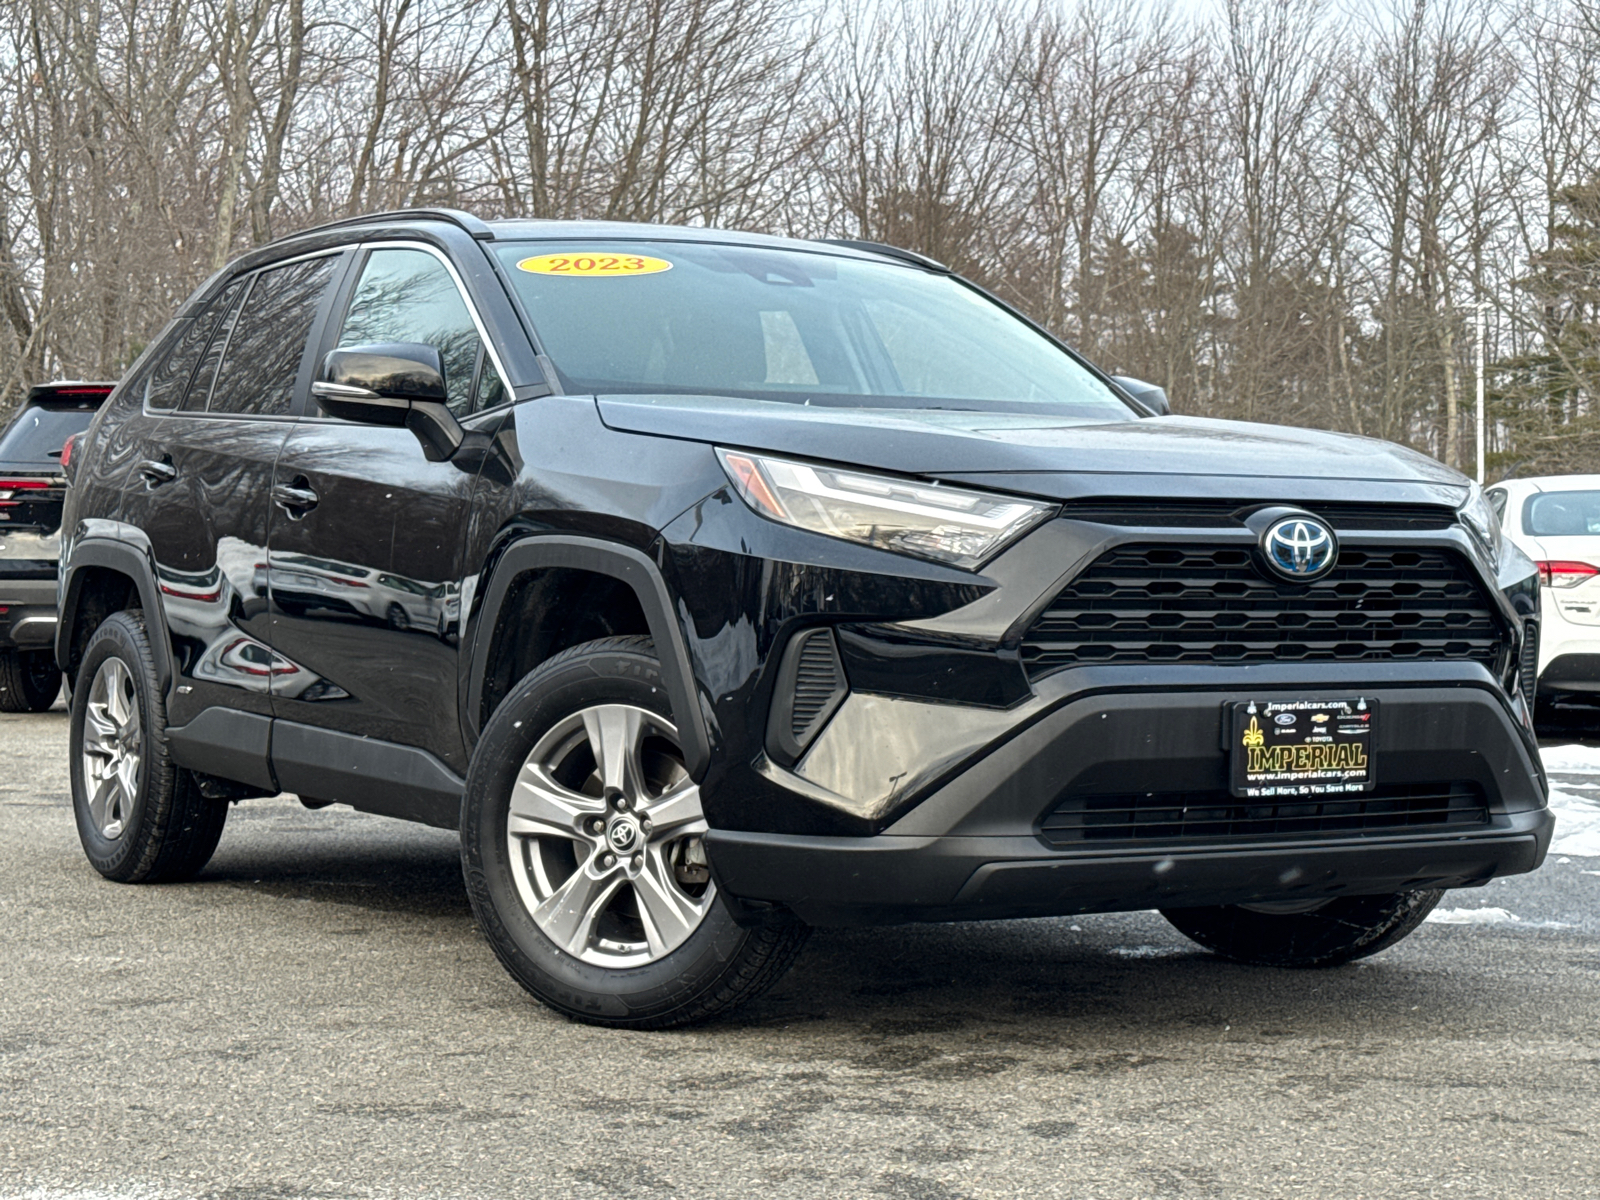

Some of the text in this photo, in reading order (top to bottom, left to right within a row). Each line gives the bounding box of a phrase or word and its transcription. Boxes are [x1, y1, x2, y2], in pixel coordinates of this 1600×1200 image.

[548, 257, 645, 272] 2023
[1267, 701, 1347, 712] Imperialcars.com
[1247, 743, 1367, 772] IMPERIAL
[1247, 769, 1366, 781] www.imperialcars.com
[1247, 783, 1364, 796] We Sell More, So You Save More
